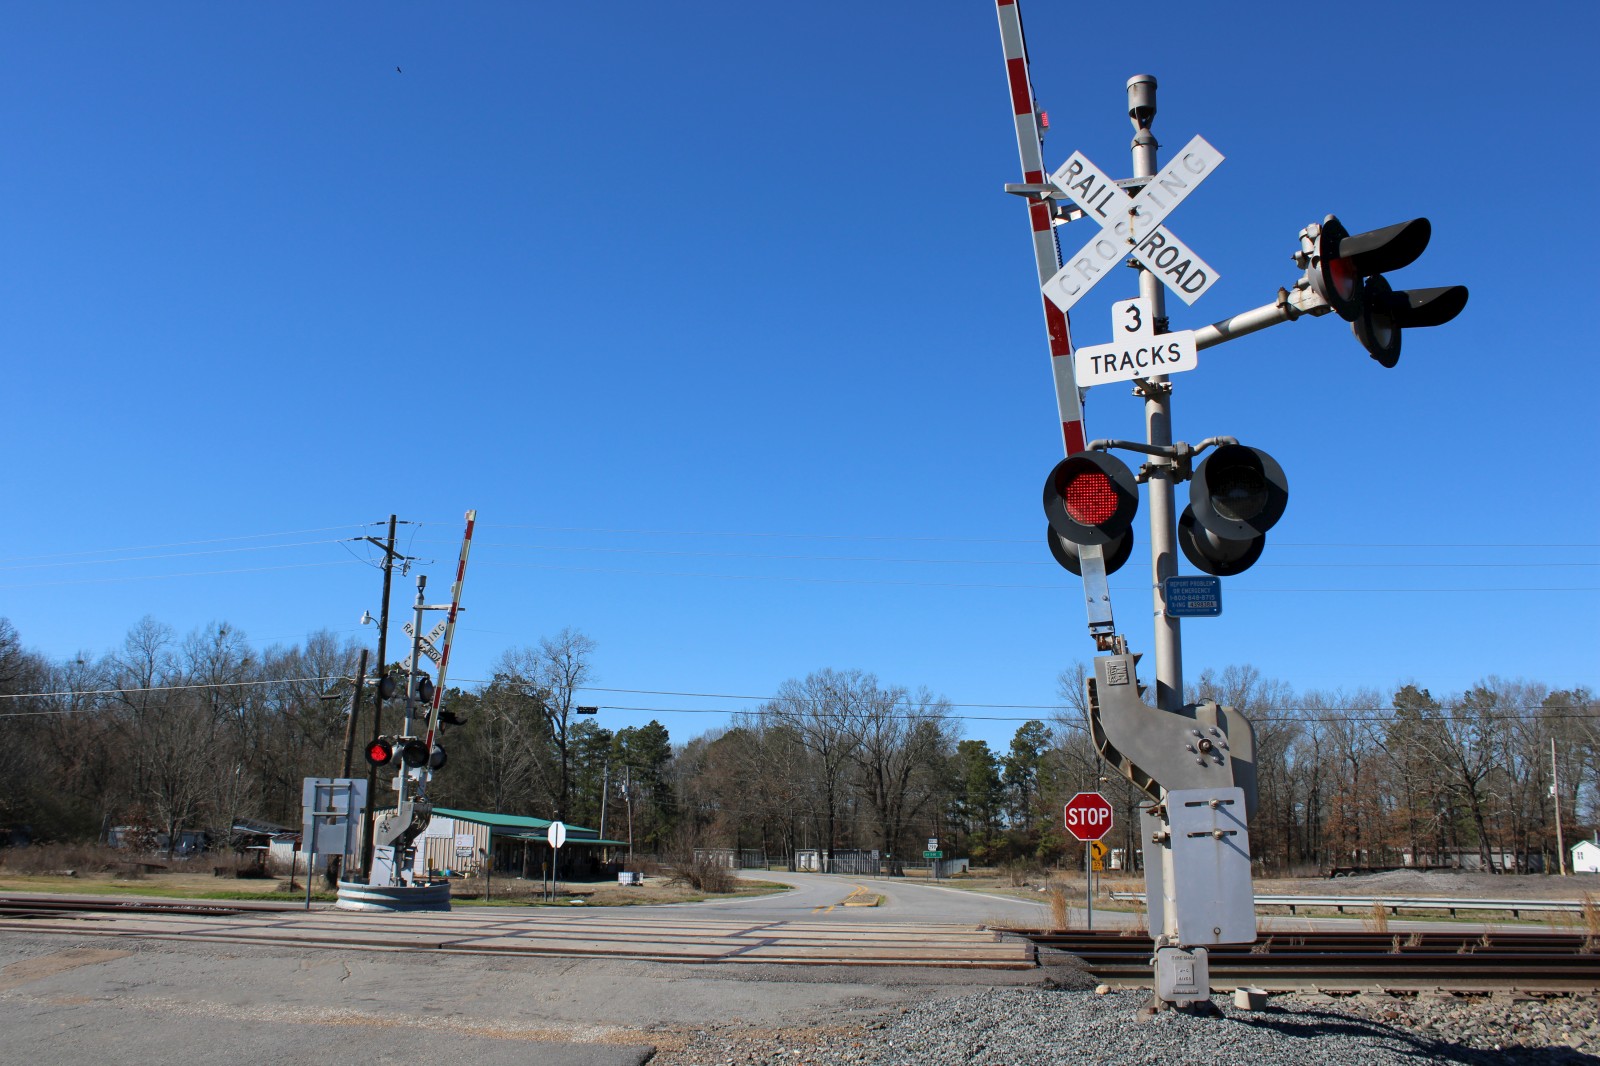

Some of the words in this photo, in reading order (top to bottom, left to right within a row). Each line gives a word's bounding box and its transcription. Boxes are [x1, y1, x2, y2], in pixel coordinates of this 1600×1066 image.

[1058, 152, 1207, 296] CROSSING
[1058, 159, 1115, 218] RAIL
[1139, 231, 1207, 294] ROAD
[1124, 305, 1142, 332] 3
[1090, 343, 1181, 375] TRACKS
[1068, 807, 1109, 826] STOP
